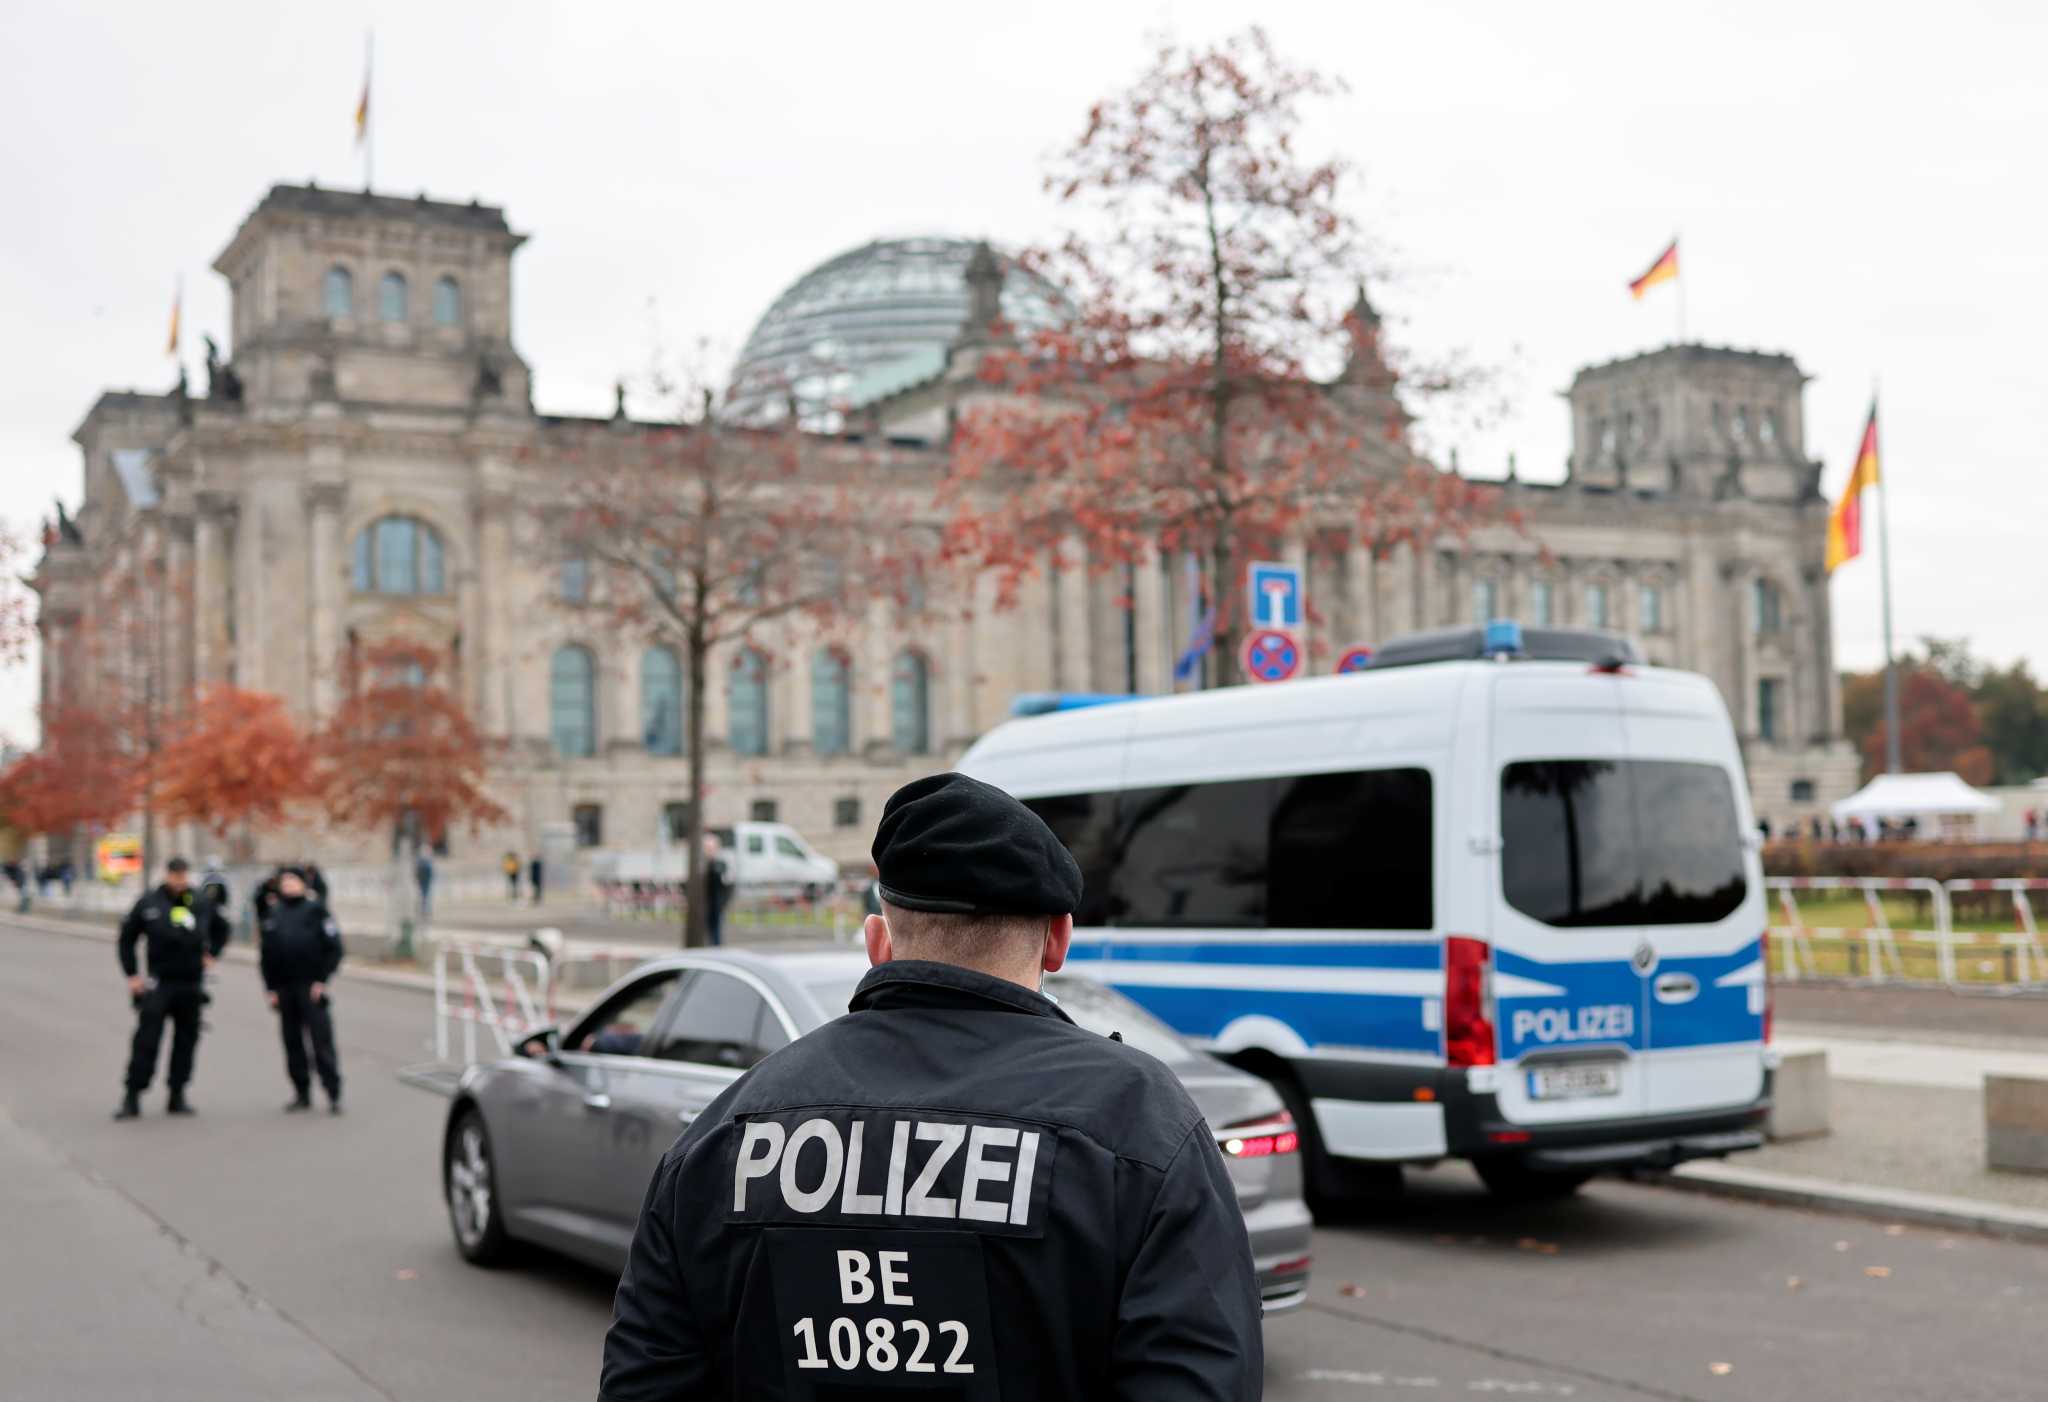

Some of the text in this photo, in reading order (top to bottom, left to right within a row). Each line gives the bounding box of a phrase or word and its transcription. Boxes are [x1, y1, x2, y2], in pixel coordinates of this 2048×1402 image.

[1513, 1004, 1634, 1043] POLIZEI
[733, 1118, 1040, 1226] POLIZEI
[836, 1249, 914, 1306] BE
[793, 1317, 975, 1375] 10822
